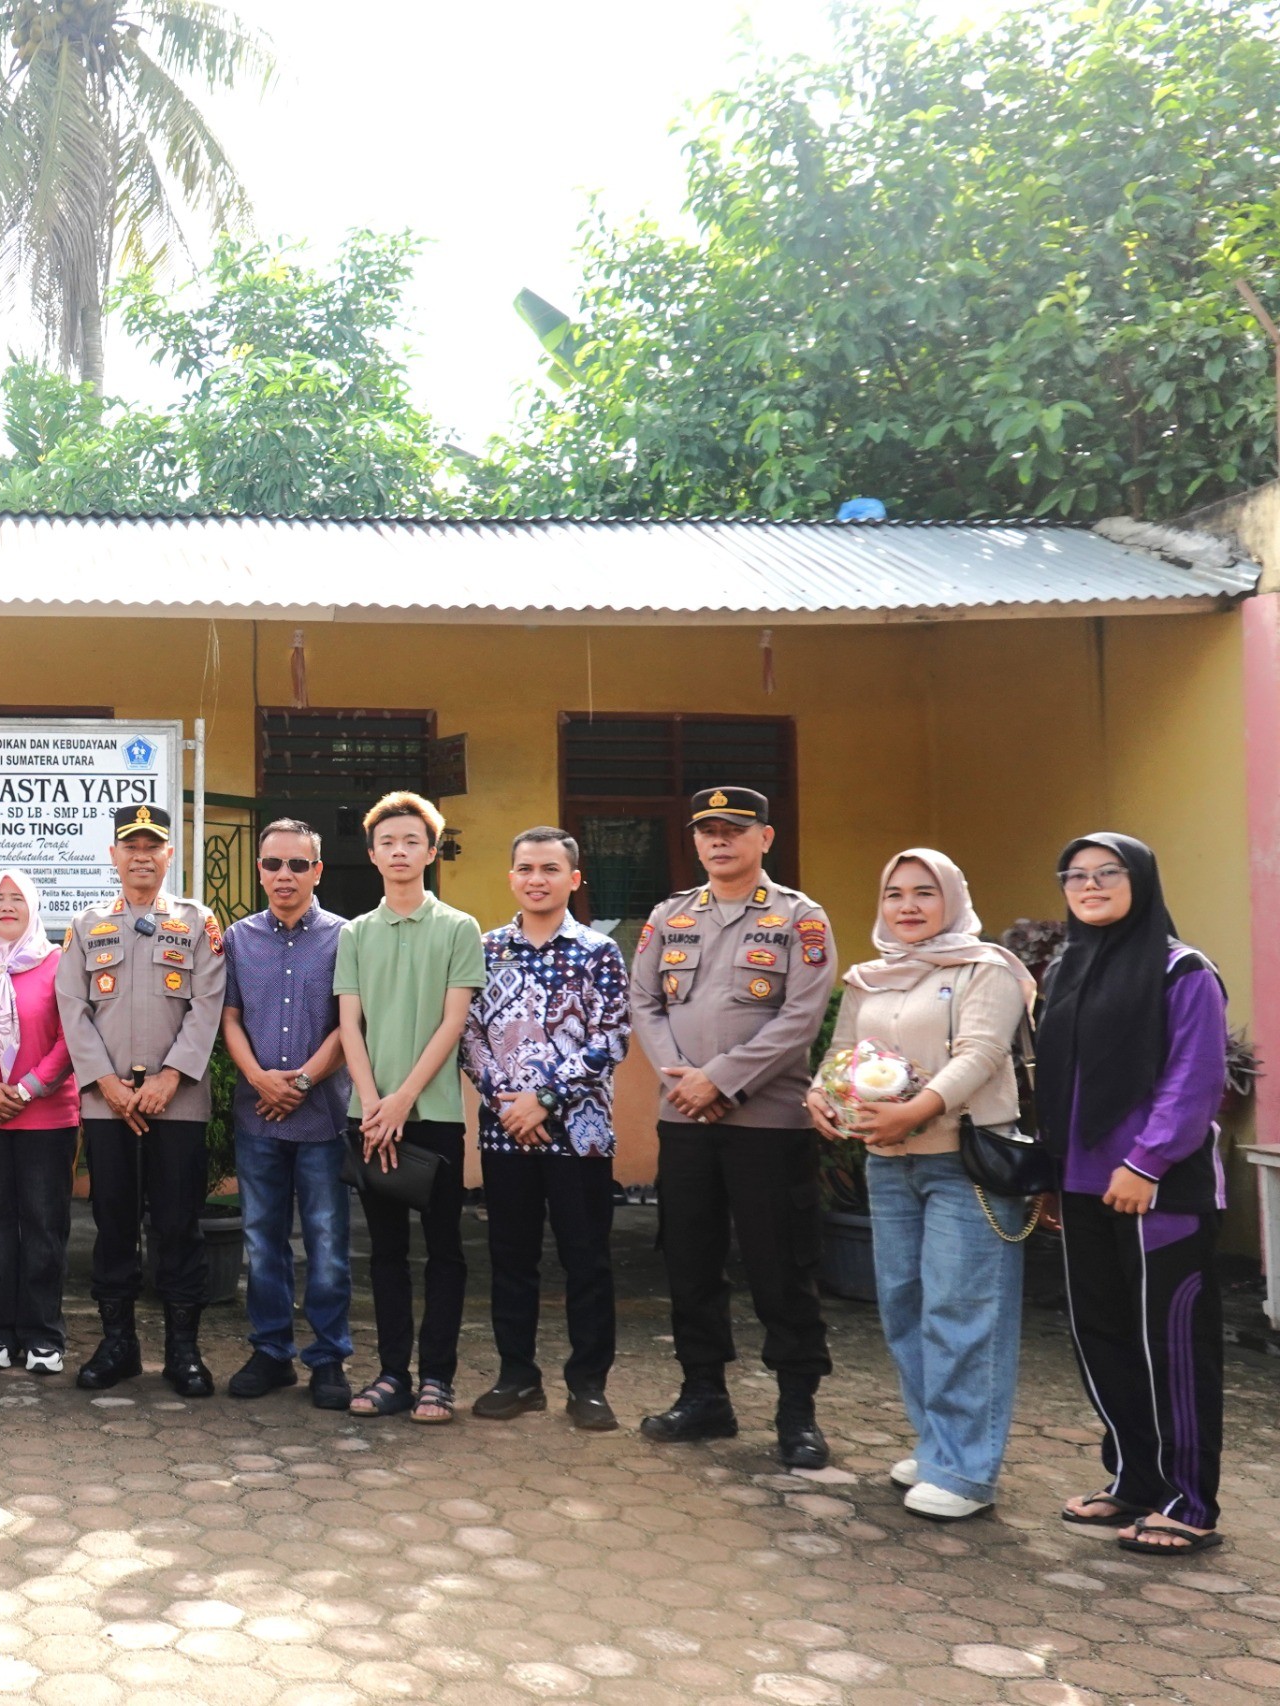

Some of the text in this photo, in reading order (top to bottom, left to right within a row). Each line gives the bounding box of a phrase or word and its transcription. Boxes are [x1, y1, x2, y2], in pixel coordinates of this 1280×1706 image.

[30, 739, 50, 750] DAN
[53, 739, 117, 750] KEBUDAYAAN
[6, 755, 59, 766] SUMATERA
[62, 755, 95, 766] UTARA
[78, 778, 156, 804] YAPSI
[7, 806, 23, 819] SD
[27, 807, 42, 819] LB
[53, 807, 79, 819] SMP
[82, 807, 98, 819] LB
[29, 822, 83, 836] TINGGI
[36, 838, 70, 851] Terapi
[58, 851, 96, 862] Khusus
[42, 889, 60, 897] Pelita
[76, 889, 99, 898] Bajenis
[49, 900, 70, 912] 0852
[157, 934, 192, 948] POLRI
[743, 932, 789, 947] POLRI
